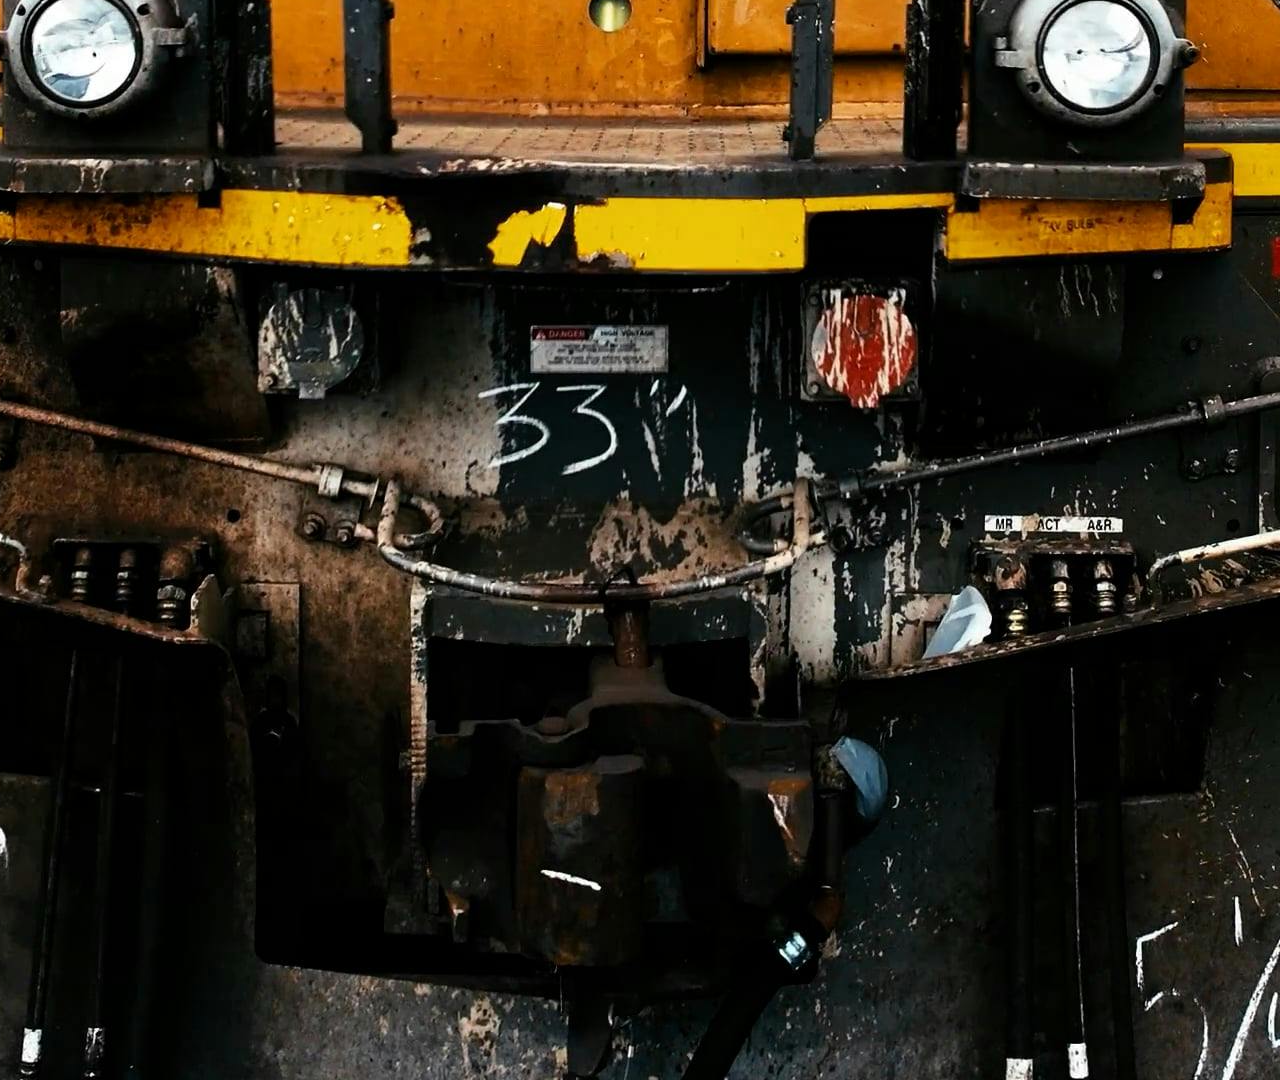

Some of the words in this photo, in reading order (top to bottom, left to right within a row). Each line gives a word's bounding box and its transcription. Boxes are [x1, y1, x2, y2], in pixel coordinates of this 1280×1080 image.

[995, 518, 1013, 530] MR
[1037, 518, 1061, 531] ACT
[1087, 519, 1112, 531] A&R
